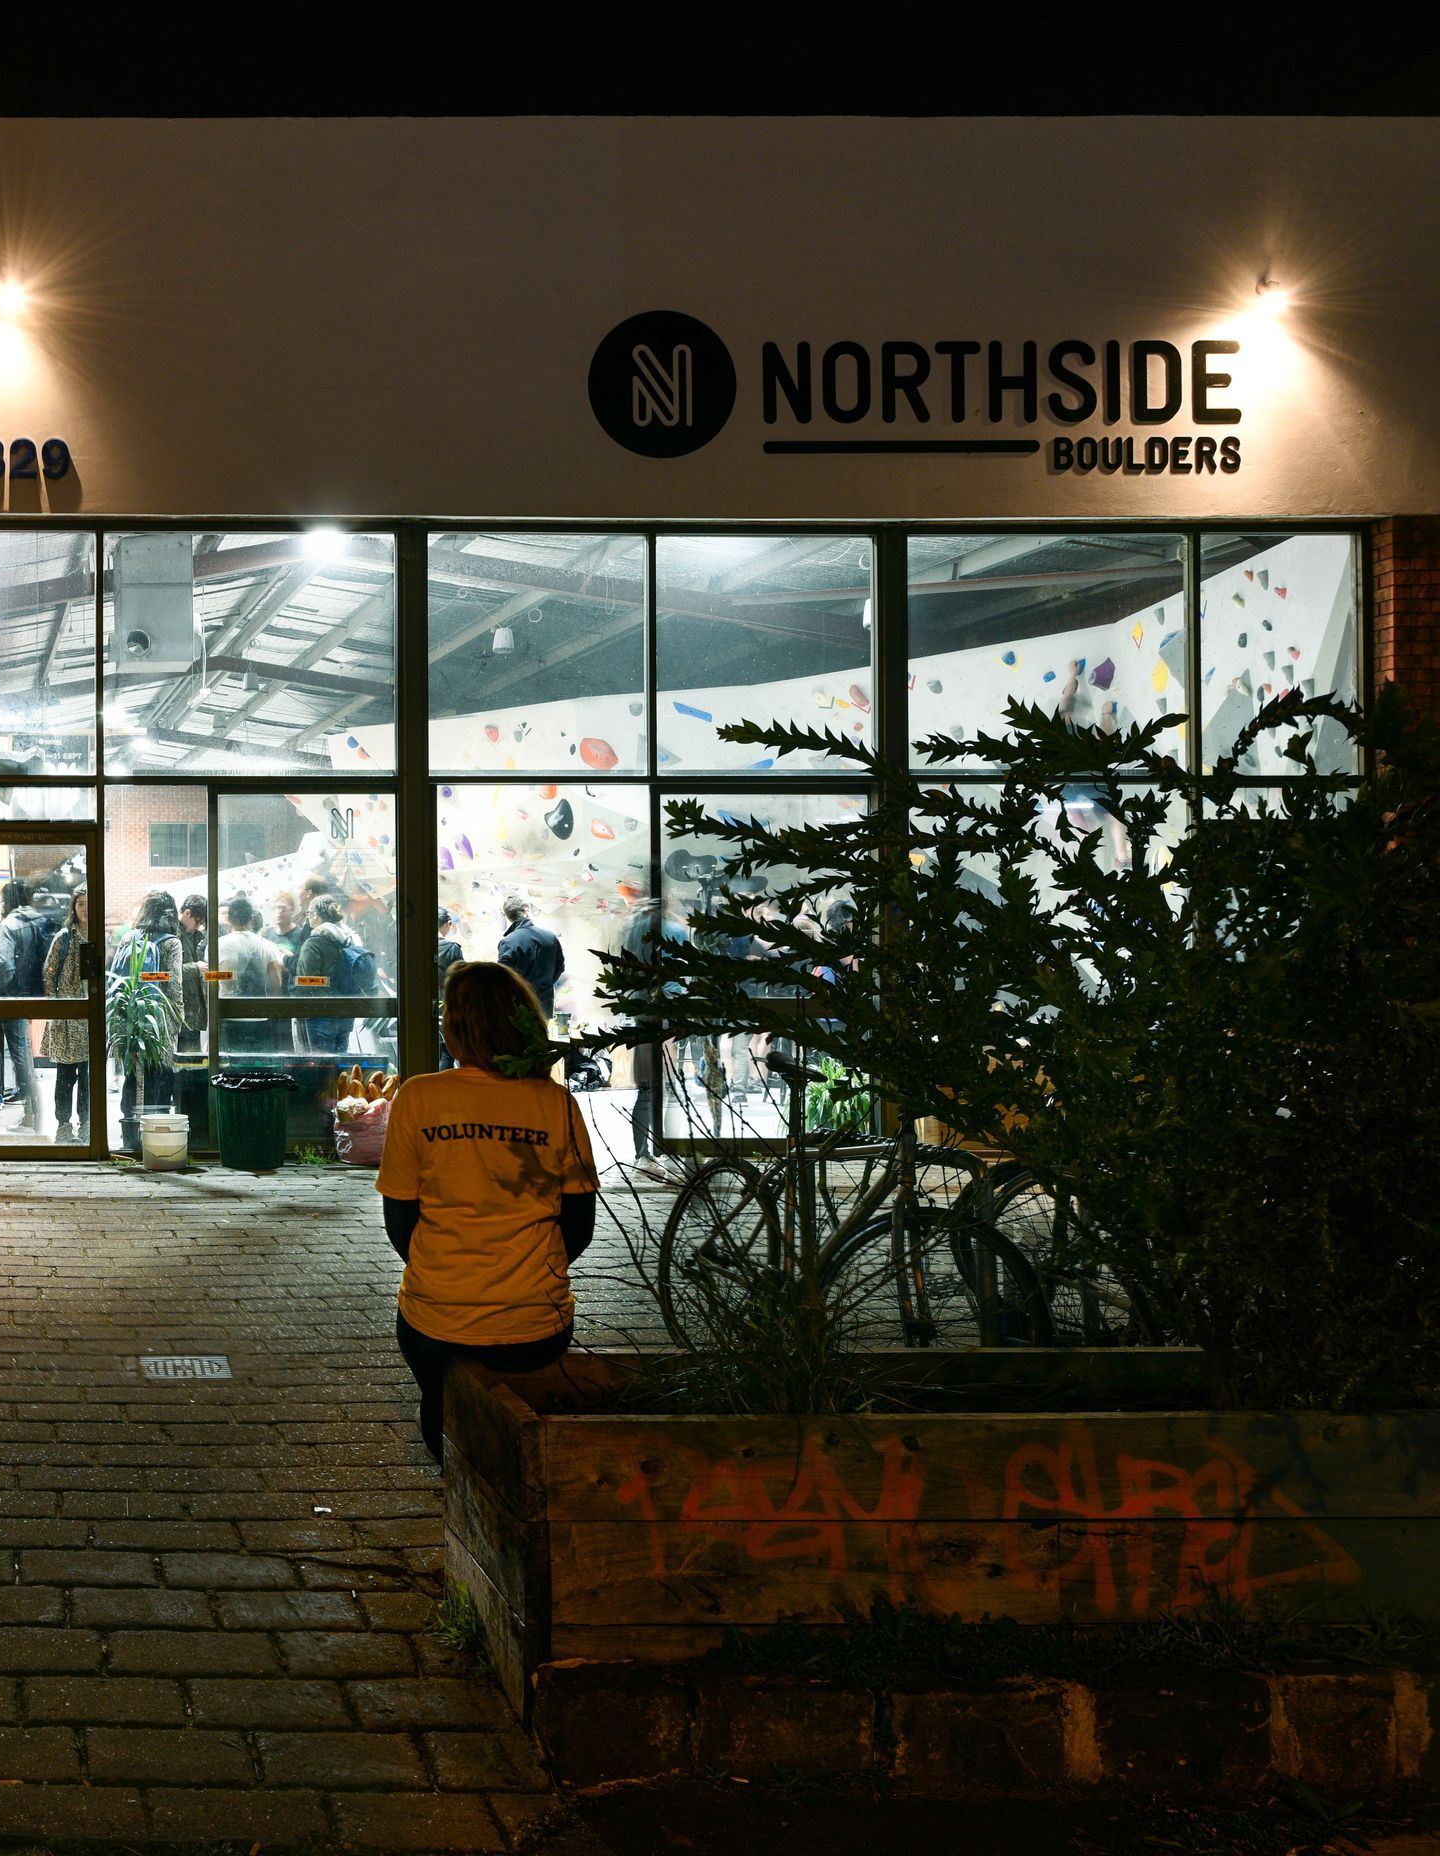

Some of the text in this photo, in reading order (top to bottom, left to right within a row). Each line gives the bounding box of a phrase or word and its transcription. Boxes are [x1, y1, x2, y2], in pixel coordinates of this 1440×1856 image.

[762, 340, 1243, 425] NORTHSIDE
[1054, 436, 1242, 474] BOULDERS
[421, 1122, 550, 1147] VOLUNTEER
